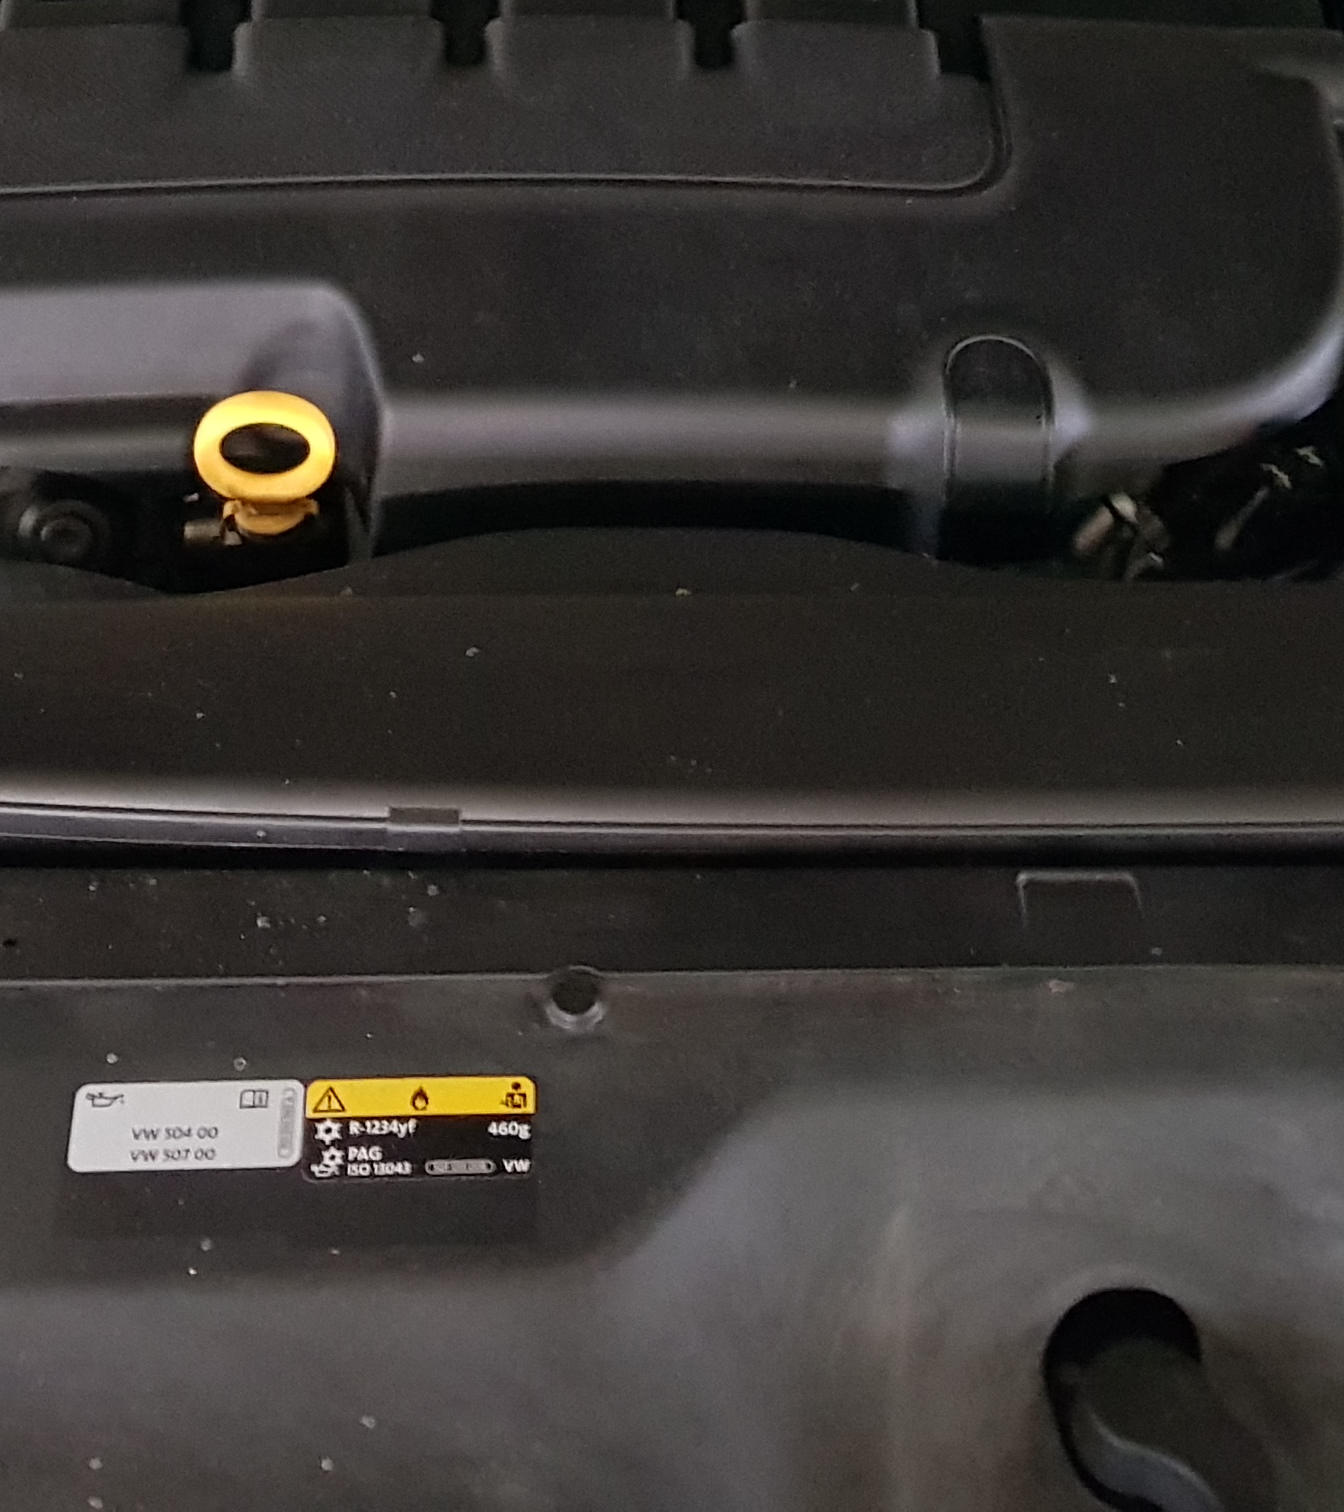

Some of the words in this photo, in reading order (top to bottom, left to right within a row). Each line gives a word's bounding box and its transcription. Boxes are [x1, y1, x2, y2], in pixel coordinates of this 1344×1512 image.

[131, 1126, 160, 1141] VW
[197, 1126, 219, 1140] 00
[349, 1119, 417, 1138] R-1234yf
[487, 1121, 531, 1140] 460g
[130, 1148, 159, 1163] VW
[194, 1148, 216, 1161] 00
[347, 1146, 383, 1161] PAG
[346, 1162, 371, 1176] ISO
[502, 1159, 531, 1173] VW
